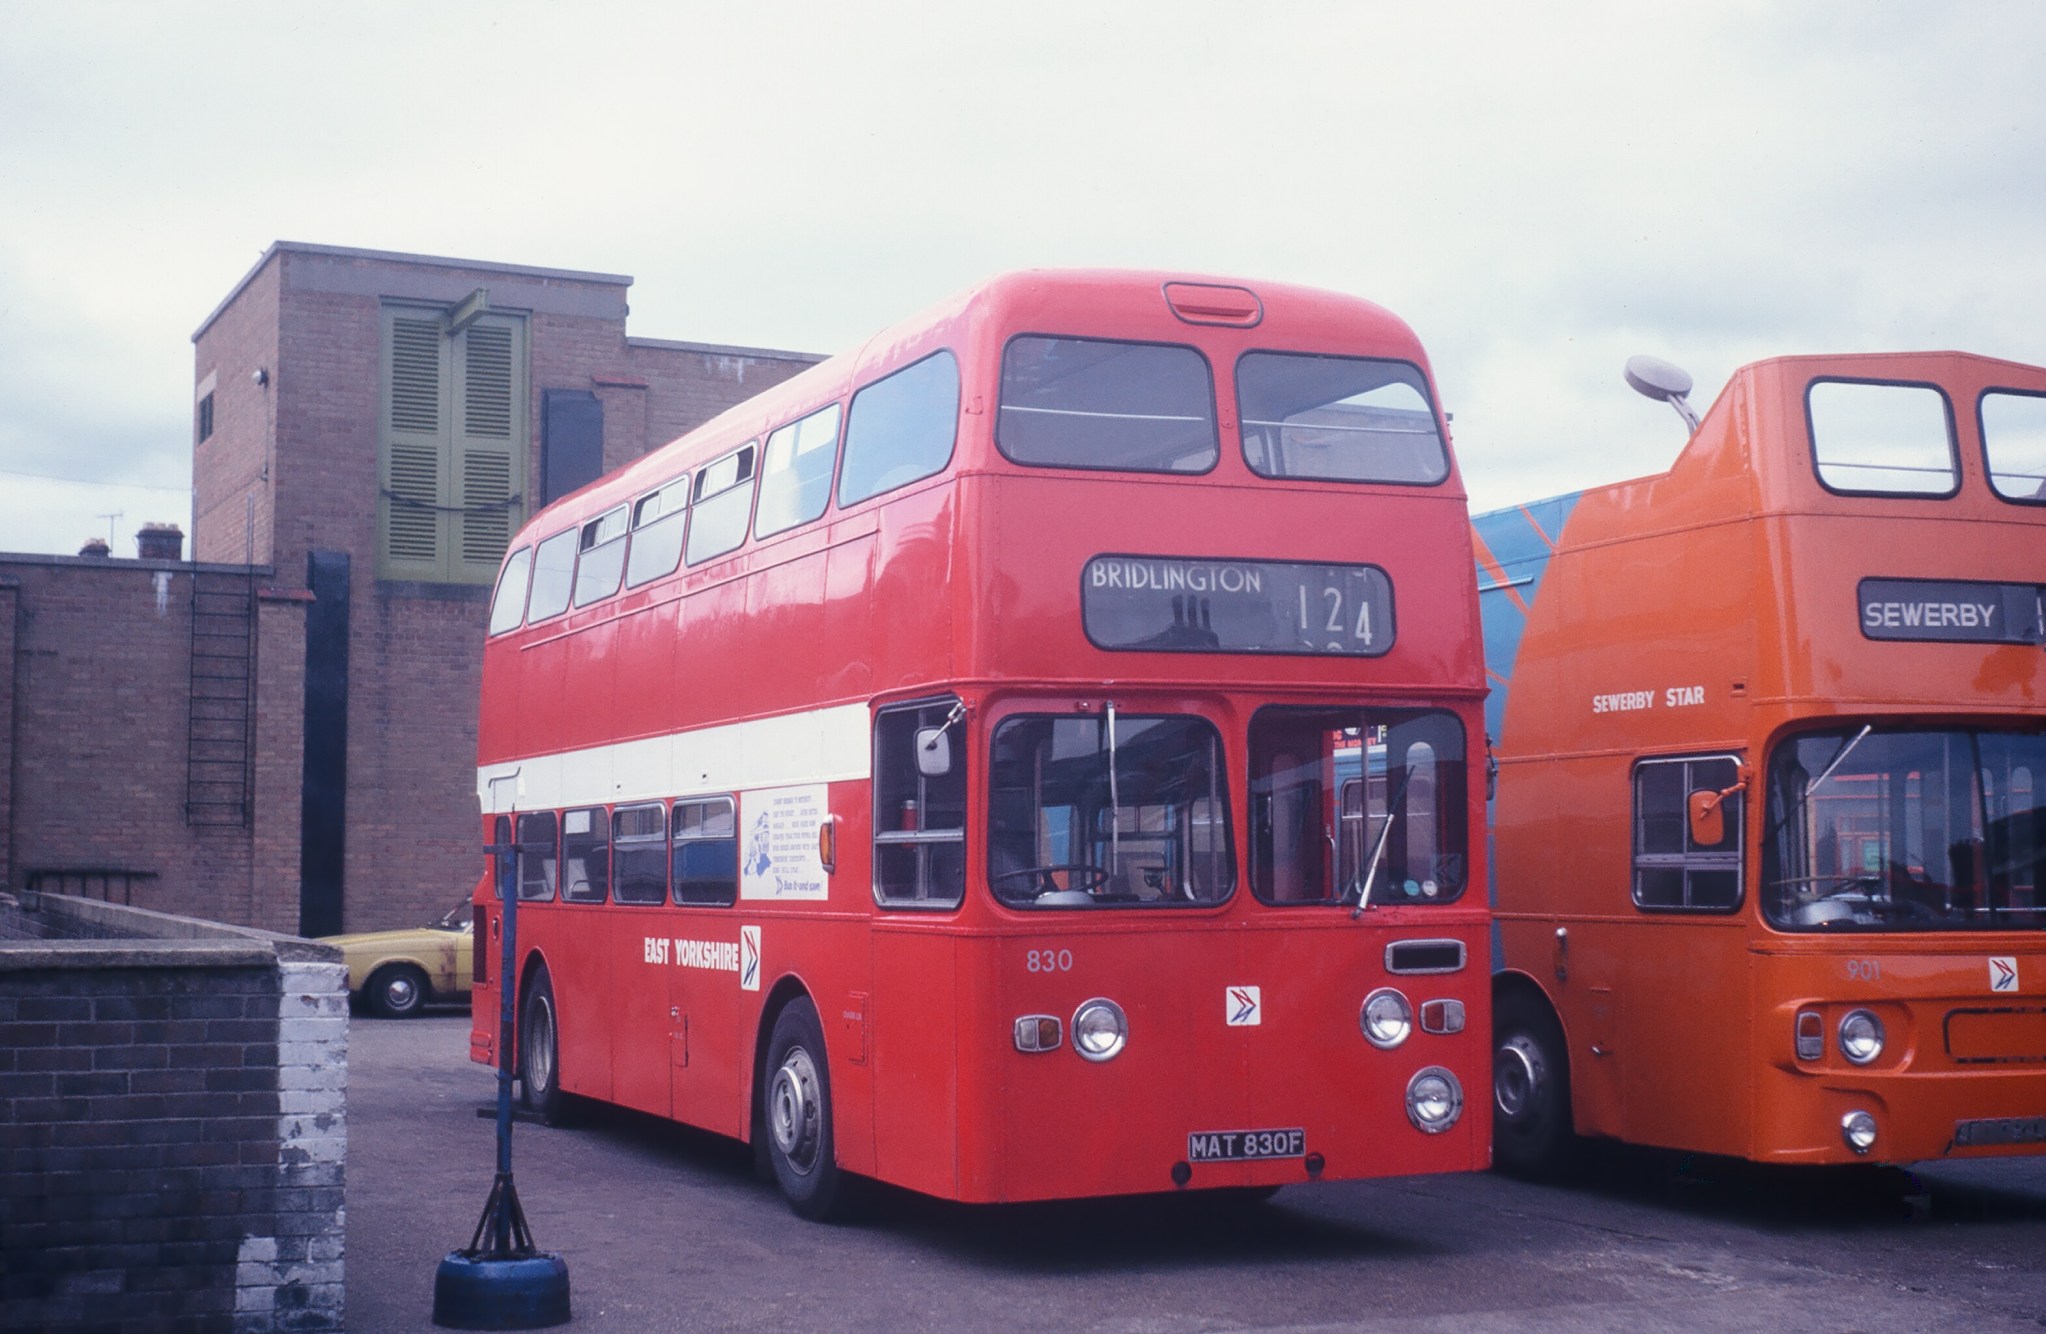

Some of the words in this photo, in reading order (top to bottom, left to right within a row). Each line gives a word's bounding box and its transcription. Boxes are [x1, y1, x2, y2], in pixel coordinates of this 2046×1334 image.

[1091, 562, 1261, 594] BRIDLINGTON
[1865, 602, 1995, 627] SEWERBY
[1592, 690, 1655, 713] SEWERBY
[1665, 686, 1705, 707] STAR
[644, 937, 670, 965] EAST
[674, 939, 739, 972] YORKSHIRE
[1027, 949, 1073, 972] 830
[1847, 960, 1880, 981] 901
[1191, 1135, 1237, 1158] MAT
[1244, 1131, 1302, 1155] 830F
